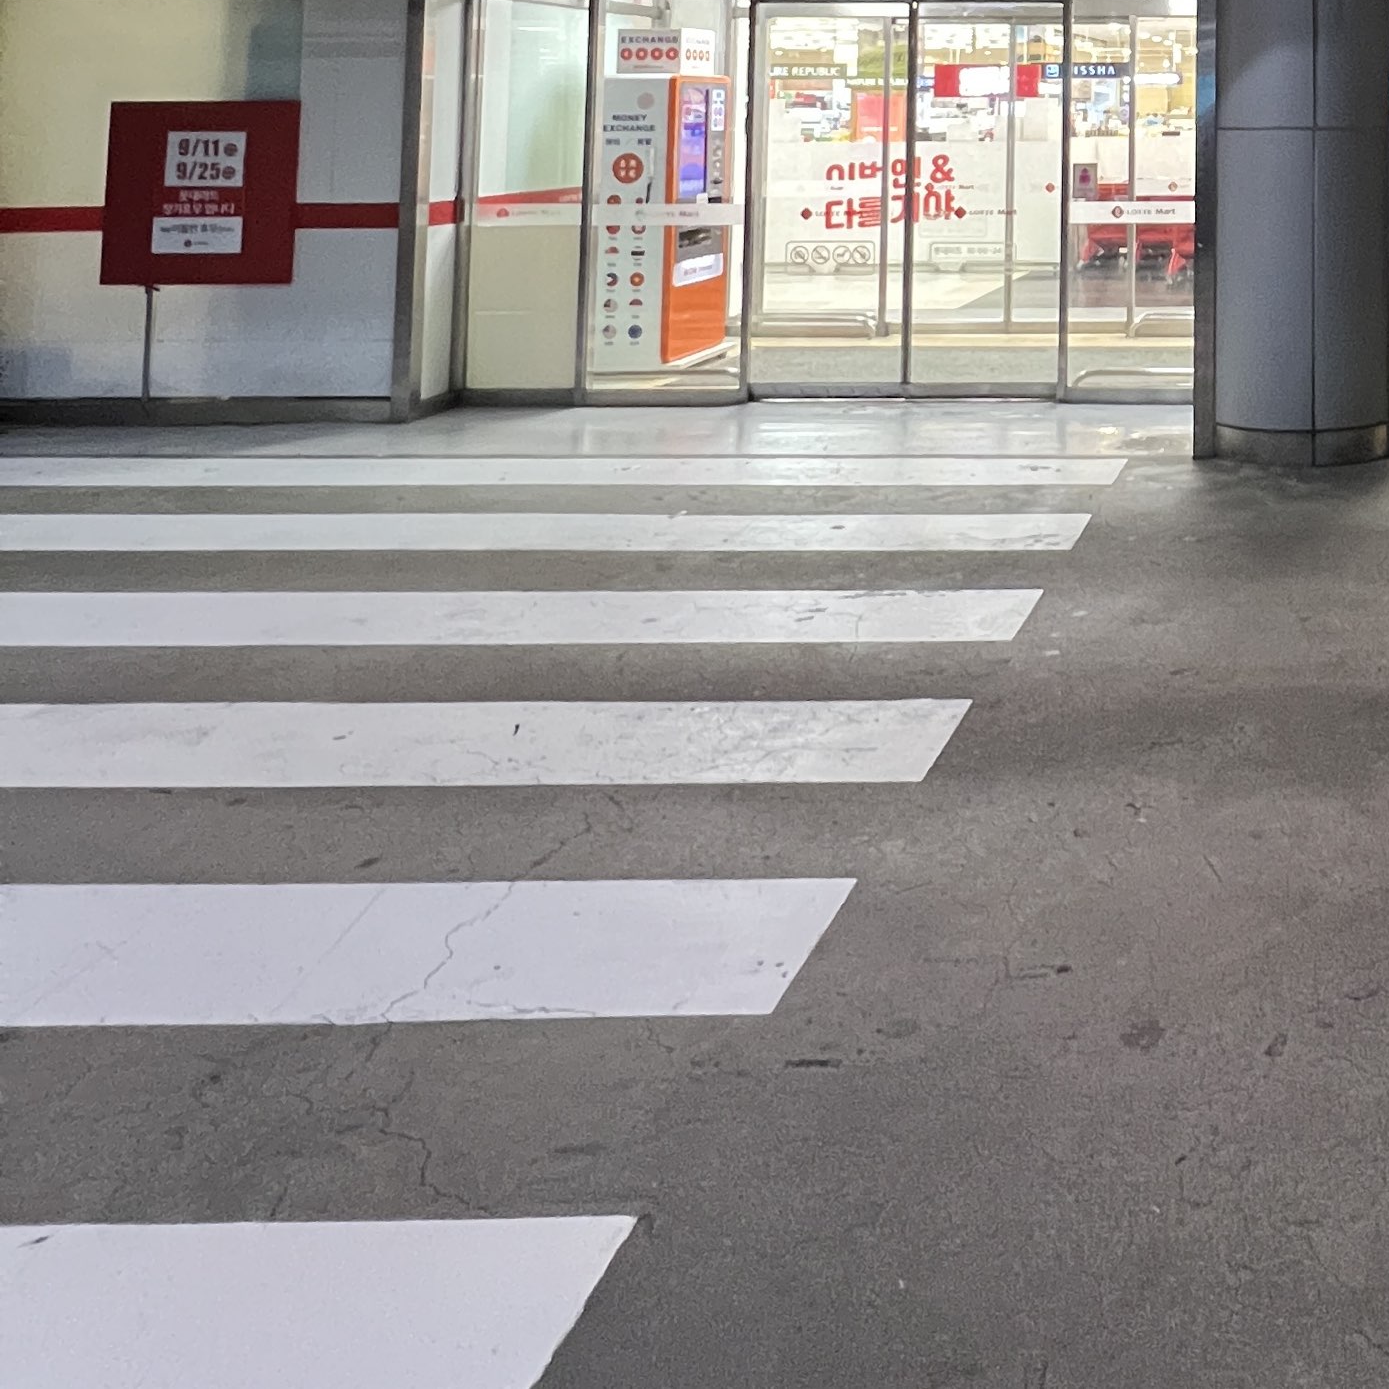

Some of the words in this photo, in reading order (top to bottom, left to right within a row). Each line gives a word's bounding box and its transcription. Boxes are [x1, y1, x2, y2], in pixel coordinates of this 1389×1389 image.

[1073, 64, 1116, 76] ISSHA
[178, 138, 220, 157] 9/11
[176, 161, 221, 181] 9/25
